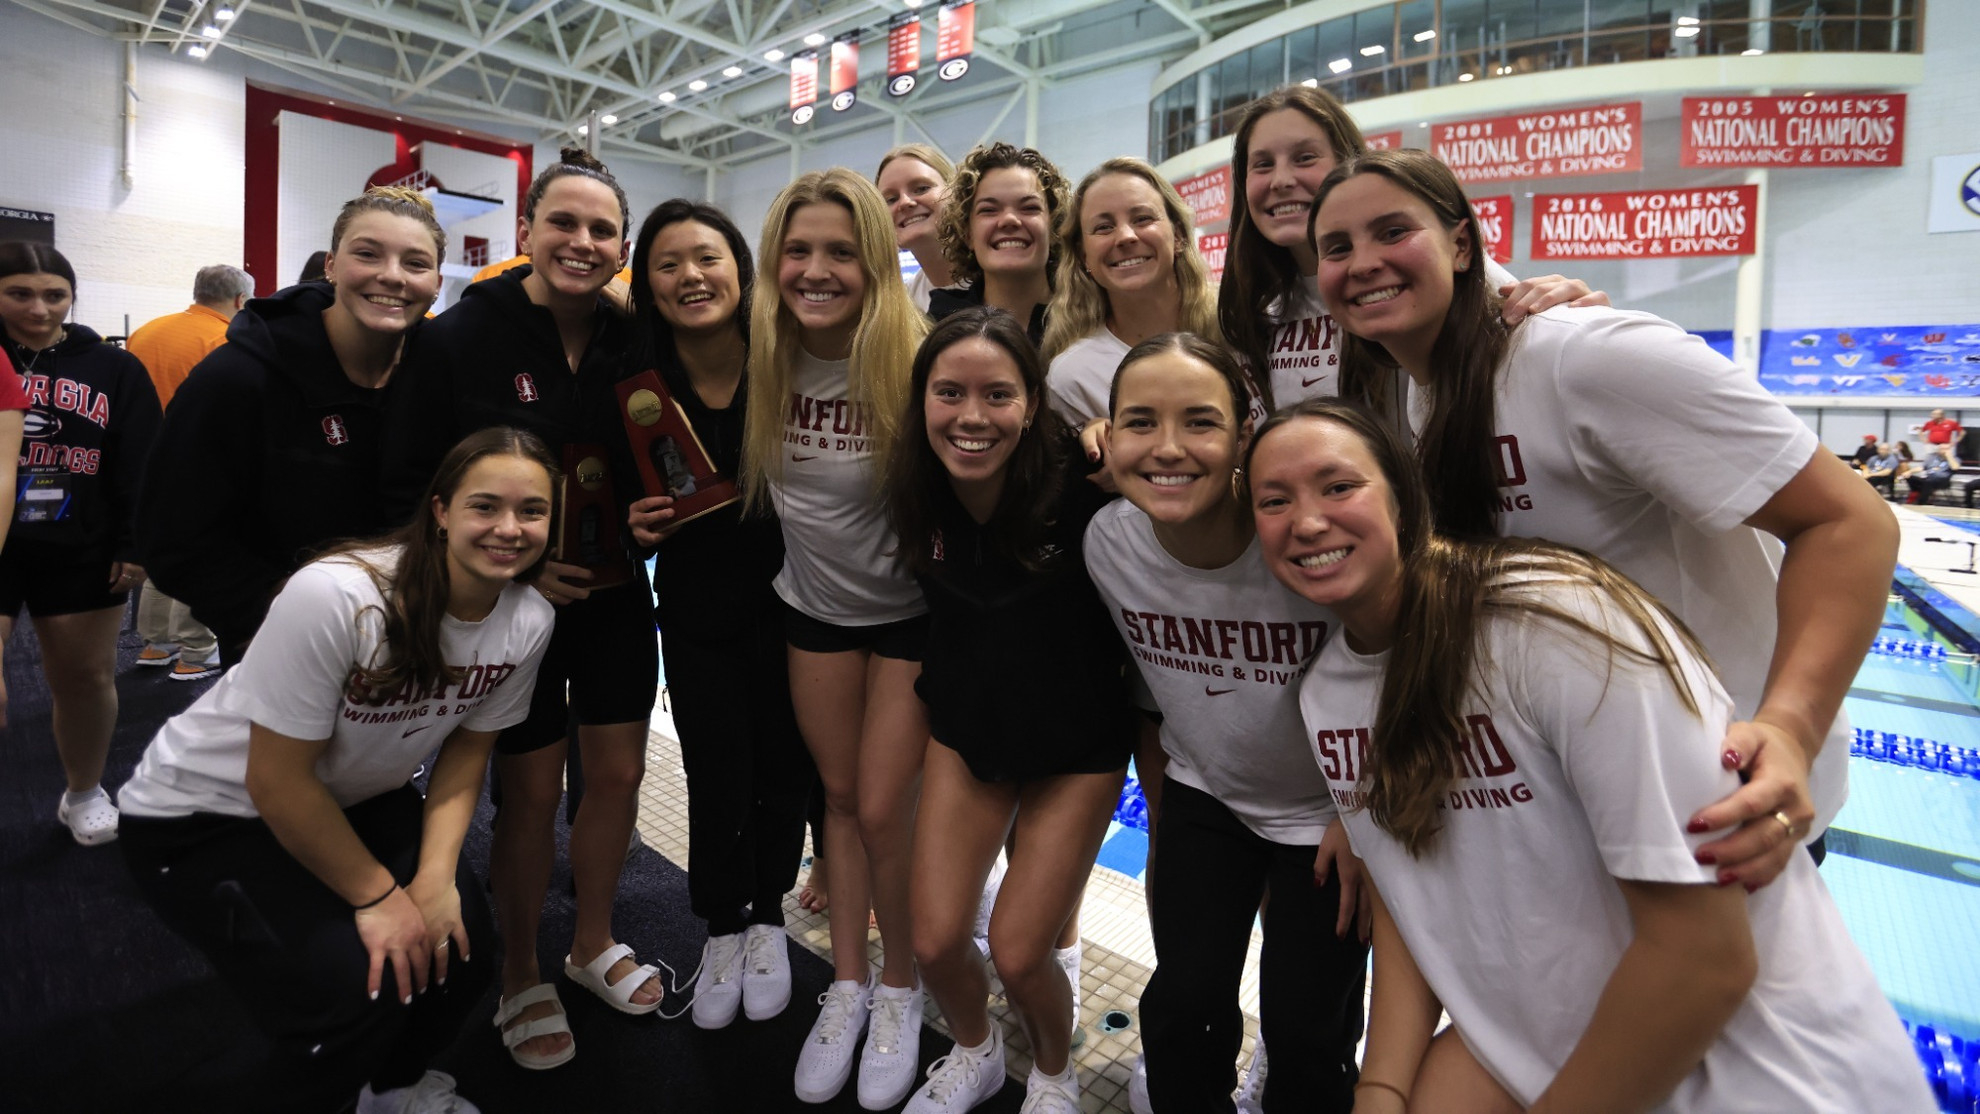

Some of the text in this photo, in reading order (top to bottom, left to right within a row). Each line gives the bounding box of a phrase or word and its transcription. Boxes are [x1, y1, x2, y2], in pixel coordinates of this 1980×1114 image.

[1698, 98, 1890, 116] 2005 WOMEN'S
[1445, 107, 1627, 140] 2001 WOMEN'S
[1691, 116, 1895, 148] NATIONAL CHAMPIONS
[1438, 123, 1633, 167] NATIONAL CHAMPIONS
[1696, 147, 1888, 164] SWIMMING & DIVING
[1452, 153, 1626, 181] WIMMING & DIVING
[0, 209, 39, 221] ORGIA
[1549, 190, 1739, 213] 2016 WOMEN'S
[1541, 207, 1746, 241] NATIONAL CHAMPIONS
[1204, 236, 1226, 249] 201
[1546, 236, 1739, 257] SWIMMING & DIVING
[1270, 354, 1338, 371] MMING &
[17, 374, 109, 429] RGIA
[818, 437, 829, 449] &
[18, 442, 101, 475] DOGS
[1121, 608, 1328, 665] STANFORD
[1133, 646, 1224, 677] SWIMMING
[1233, 667, 1246, 680] &
[343, 704, 429, 724] WIMMING
[436, 705, 448, 716] &
[1449, 782, 1534, 809] DIVING
